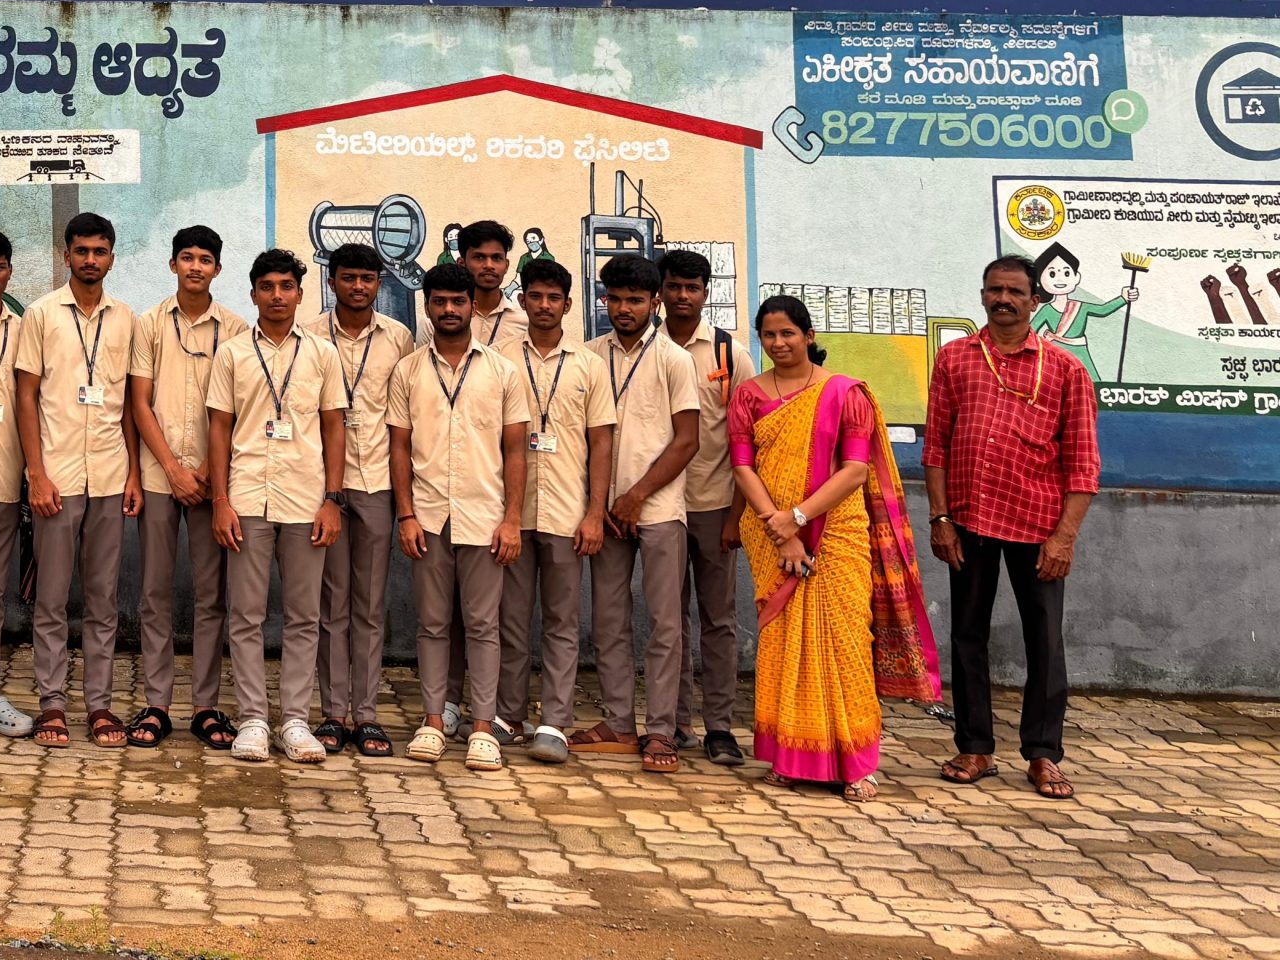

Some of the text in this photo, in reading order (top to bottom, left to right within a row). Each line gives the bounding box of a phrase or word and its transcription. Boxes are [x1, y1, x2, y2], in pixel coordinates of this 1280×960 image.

[93, 27, 225, 118] ಆದ್ಯತೆ
[802, 51, 1100, 91] ಏಕೀಕೃತ ಸಹಾಯವಾಣಿಗೆ
[857, 93, 881, 104] ಕರೆ
[931, 94, 976, 109] ಮತ್ತು
[821, 110, 1112, 149] 8277506000
[484, 133, 566, 161] ರಿಕವರಿ
[1067, 209, 1110, 223] ಗ್ರಾಮೀಣ
[1115, 209, 1163, 221] ಕುಡಿಯುವ
[1167, 210, 1192, 221] ನೀರು
[1196, 212, 1224, 226] ಮತ್ತು
[1100, 387, 1169, 406] ಭಾರತ್
[1176, 390, 1247, 409] ಮಿಷನ್
